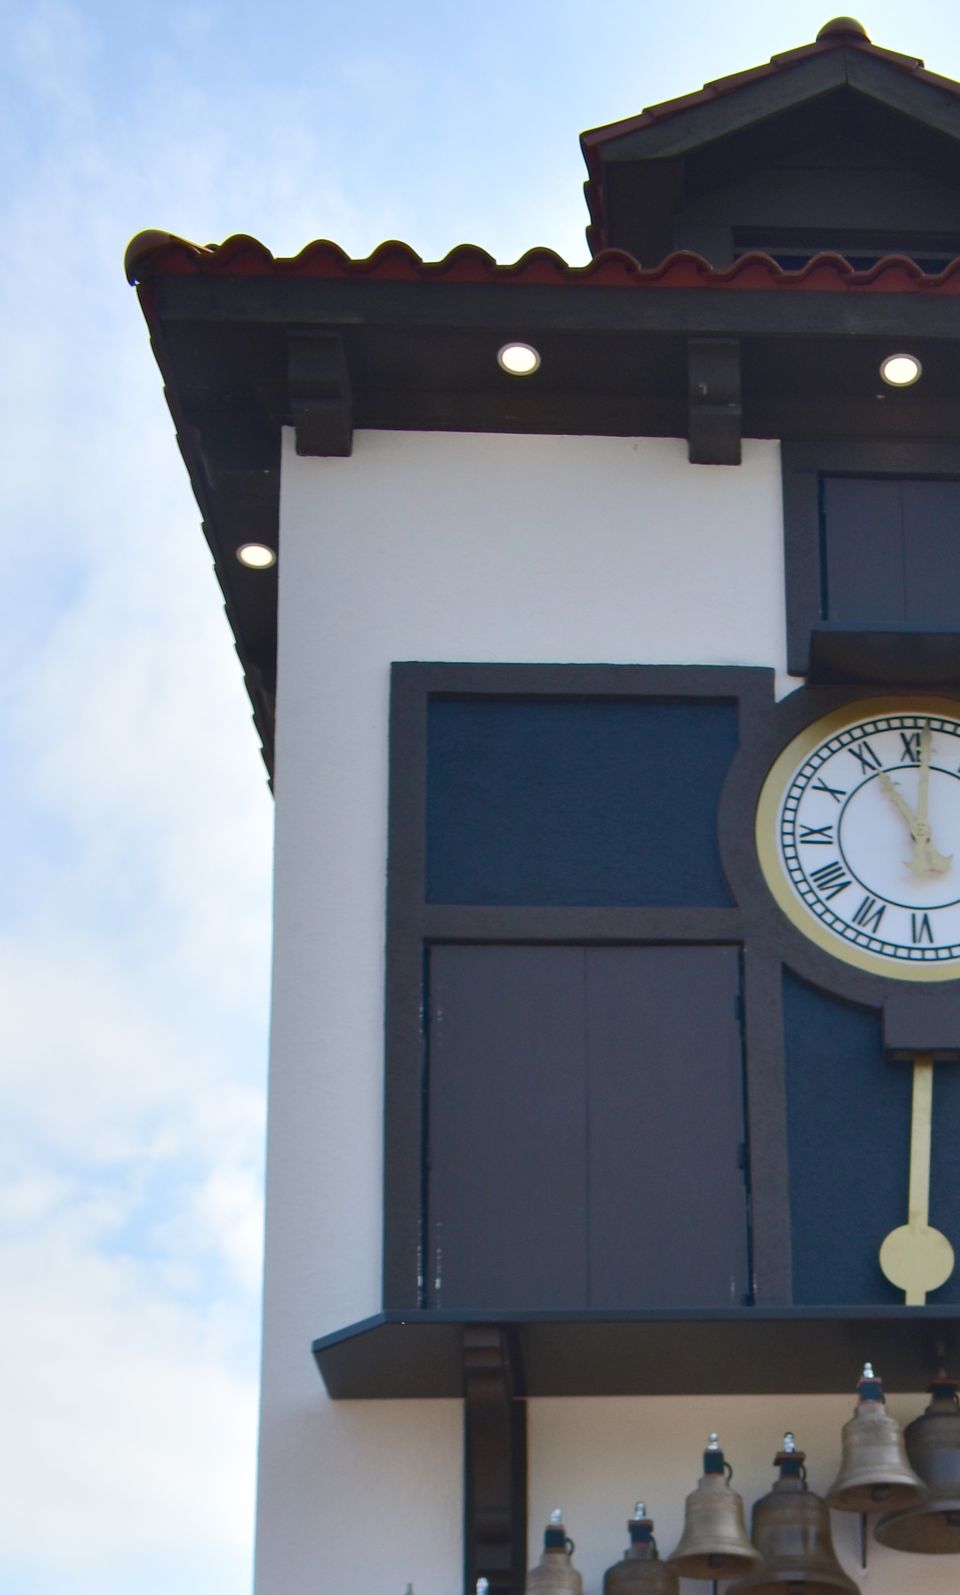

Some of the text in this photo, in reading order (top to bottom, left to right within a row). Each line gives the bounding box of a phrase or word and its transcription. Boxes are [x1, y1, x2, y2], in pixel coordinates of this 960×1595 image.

[847, 741, 882, 774] XI
[811, 777, 847, 803] X
[799, 824, 834, 845] IX
